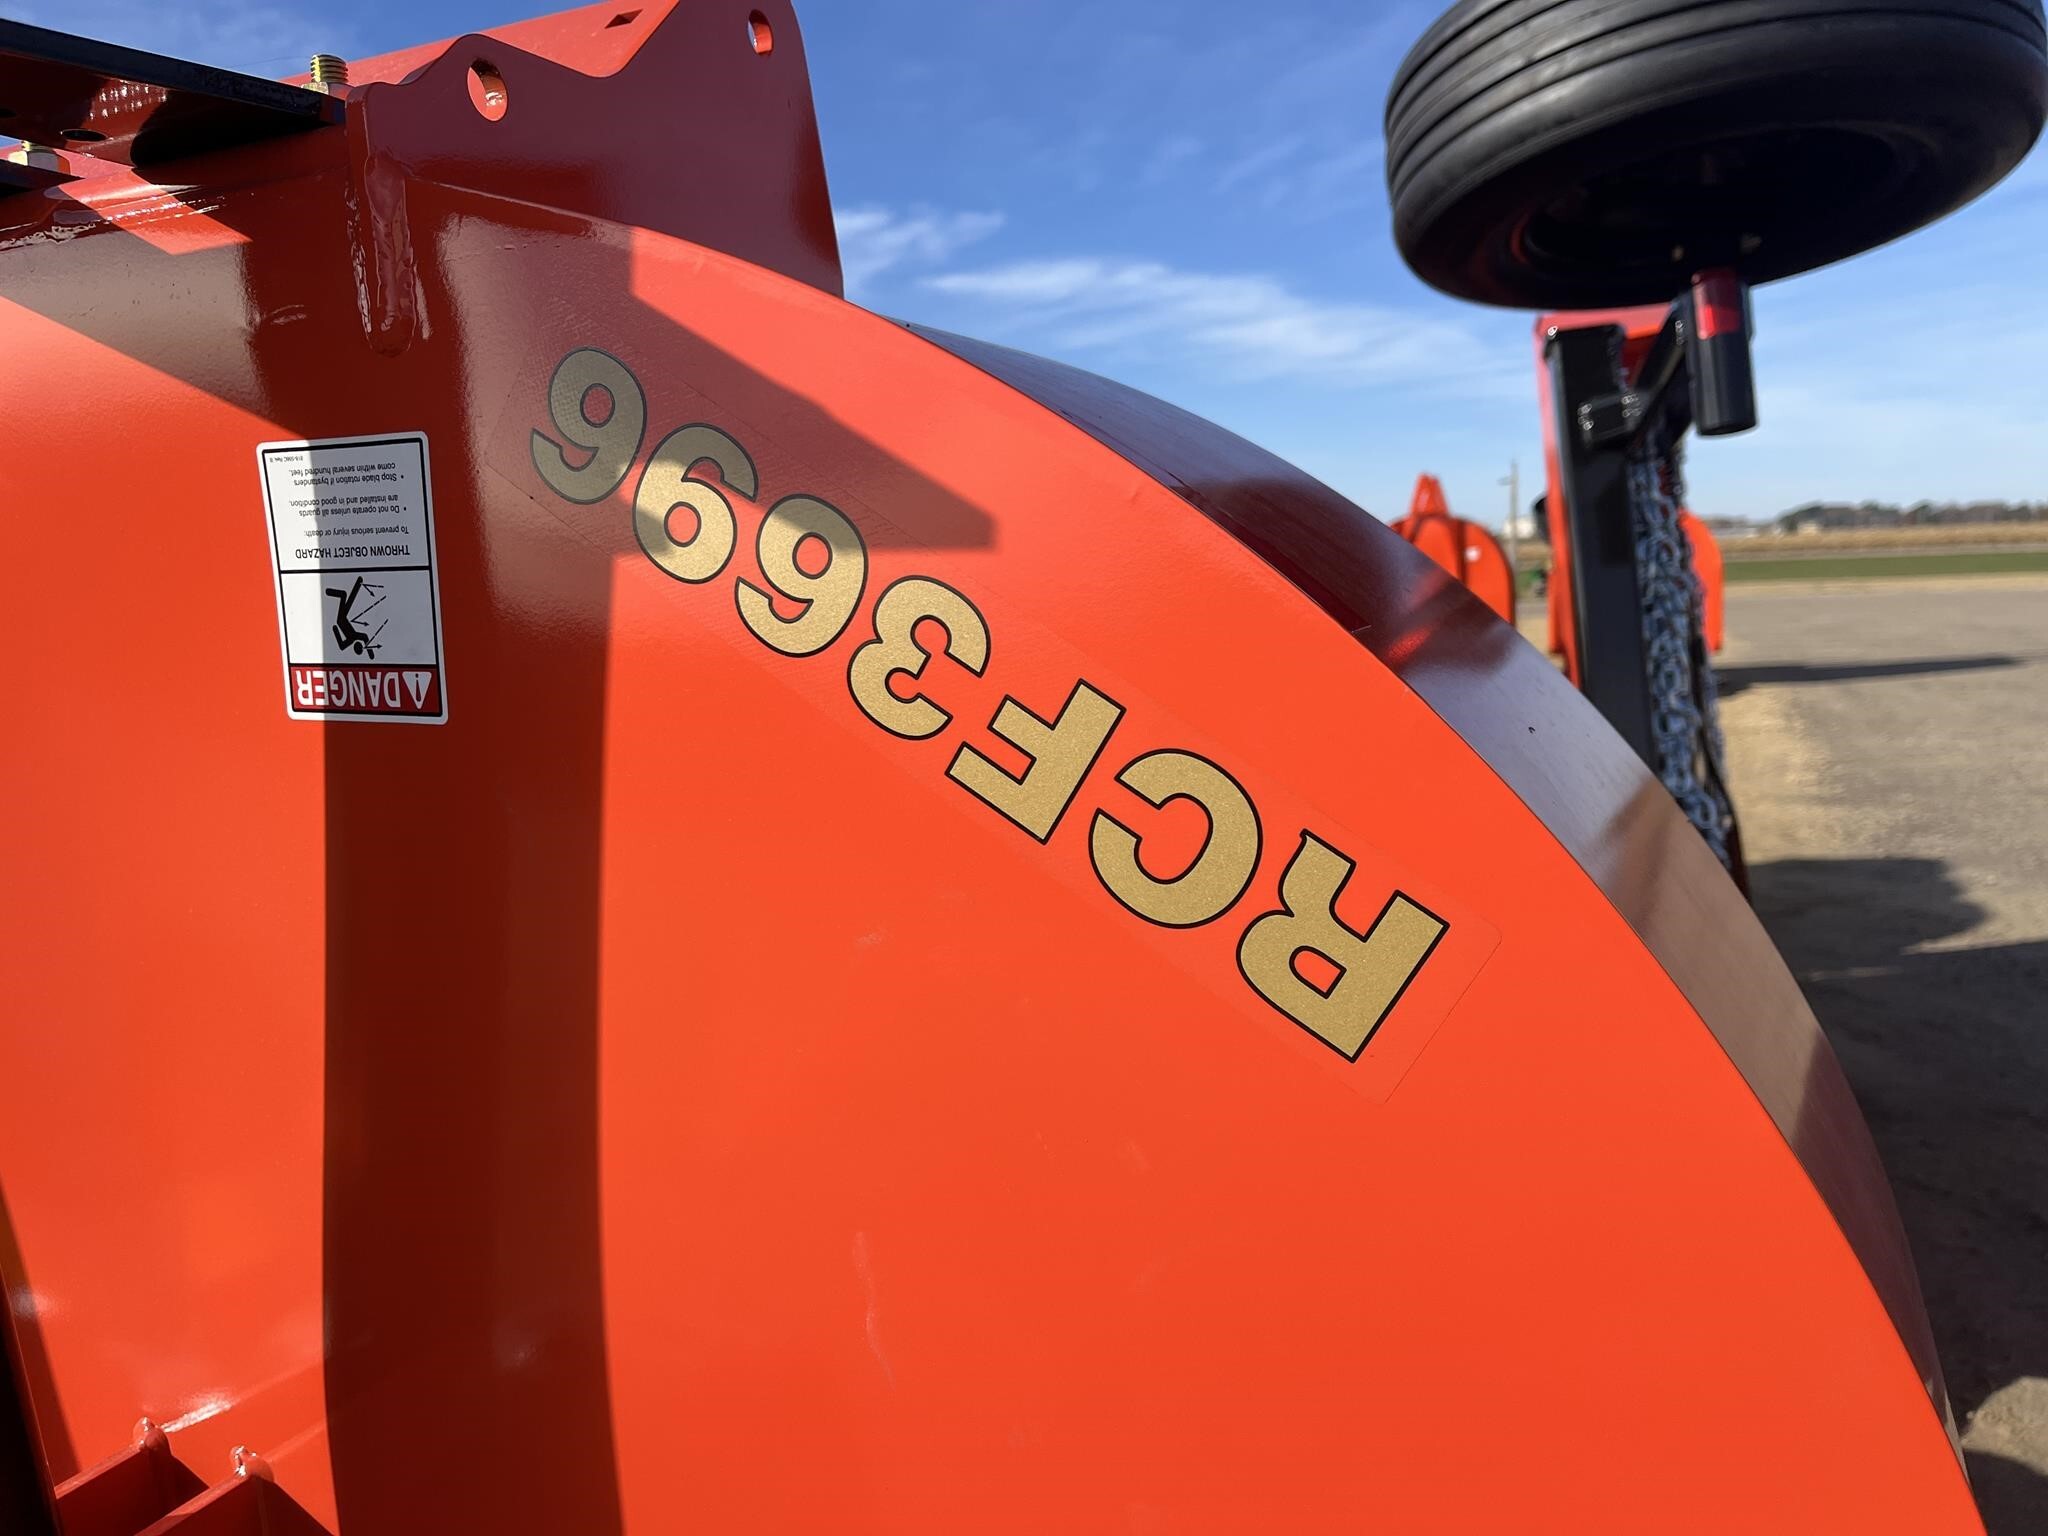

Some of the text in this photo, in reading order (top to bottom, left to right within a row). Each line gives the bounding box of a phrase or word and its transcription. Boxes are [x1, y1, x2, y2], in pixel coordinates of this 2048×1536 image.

[332, 466, 355, 475] several
[356, 464, 376, 473] within
[377, 462, 396, 470] come
[305, 466, 331, 477] hundred
[294, 472, 397, 487] Stop blade rotation if bystanders
[321, 496, 338, 506] good
[339, 497, 345, 505] in
[346, 497, 358, 505] and
[360, 495, 387, 504] installed
[299, 505, 400, 517] Do not operate unless all guards
[333, 527, 350, 536] injury
[351, 528, 374, 536] serious
[375, 524, 400, 534] prevent
[401, 525, 409, 534] To
[295, 545, 410, 559] THROWN OBJECT HAZARD
[296, 670, 401, 708] DANGER
[530, 347, 1450, 1063] RCF3696
